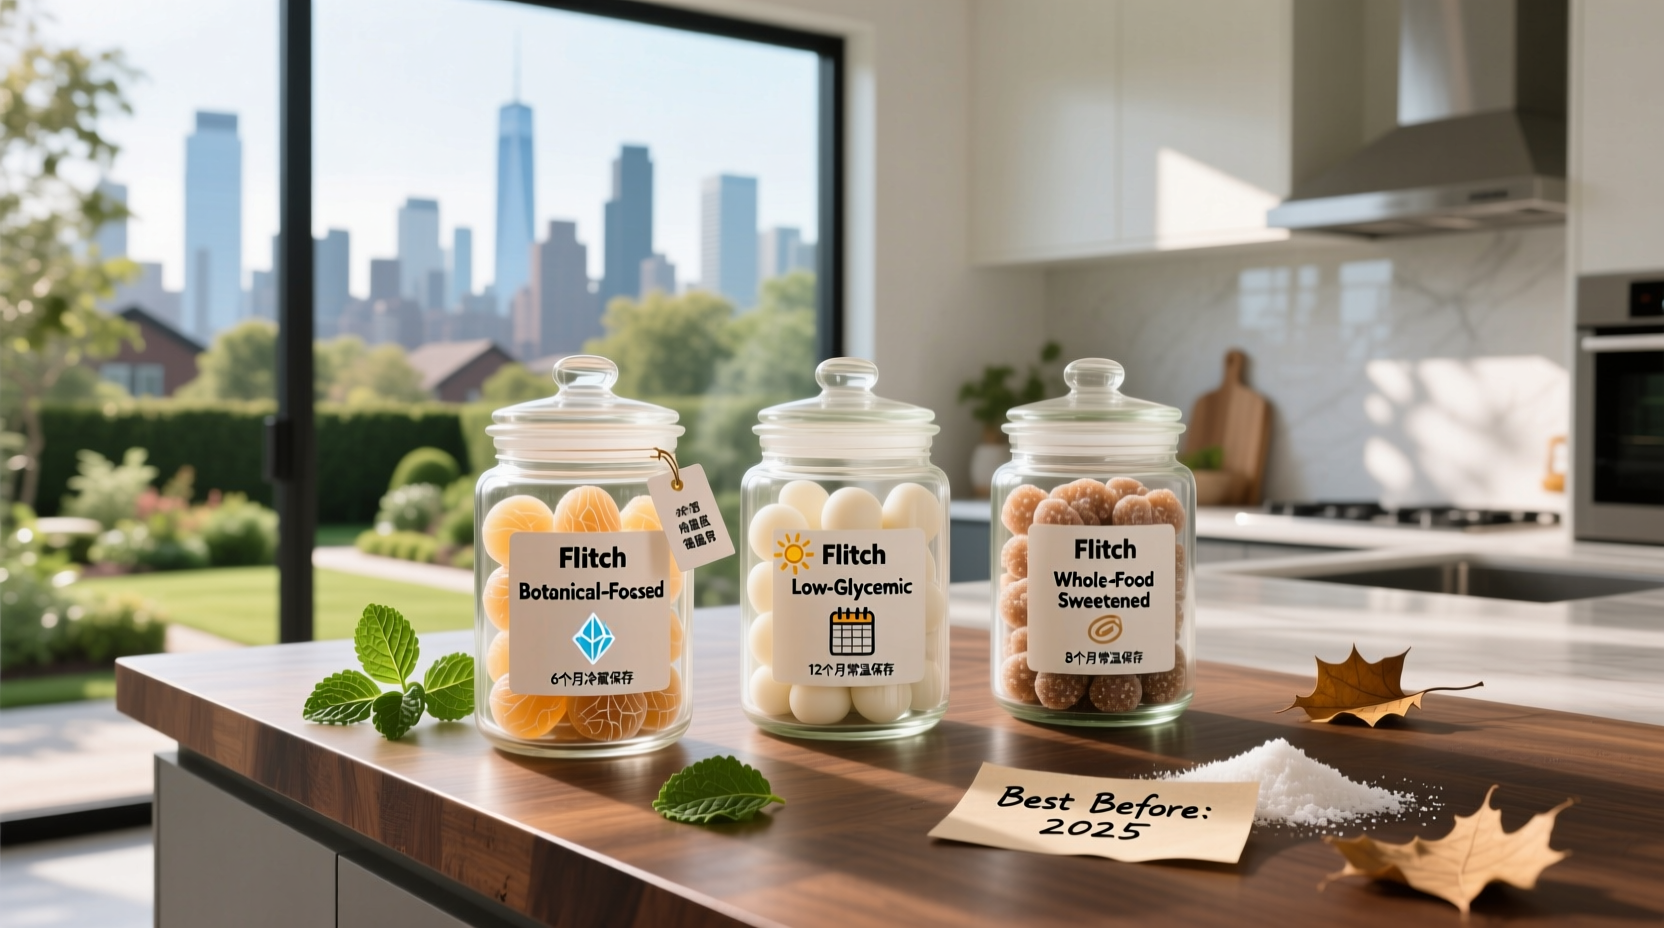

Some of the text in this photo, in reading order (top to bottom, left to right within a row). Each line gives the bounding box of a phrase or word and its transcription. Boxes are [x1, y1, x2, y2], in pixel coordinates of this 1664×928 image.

[559, 545, 627, 569] Flitch
[822, 543, 886, 566] Flitch
[1074, 538, 1137, 560] Flitch
[792, 577, 913, 601] Low-Glycemic
[1053, 570, 1154, 588] Whole-Food
[1057, 591, 1151, 609] Sweetened
[997, 785, 1212, 820] Best Before:
[1039, 817, 1152, 841] 2025
